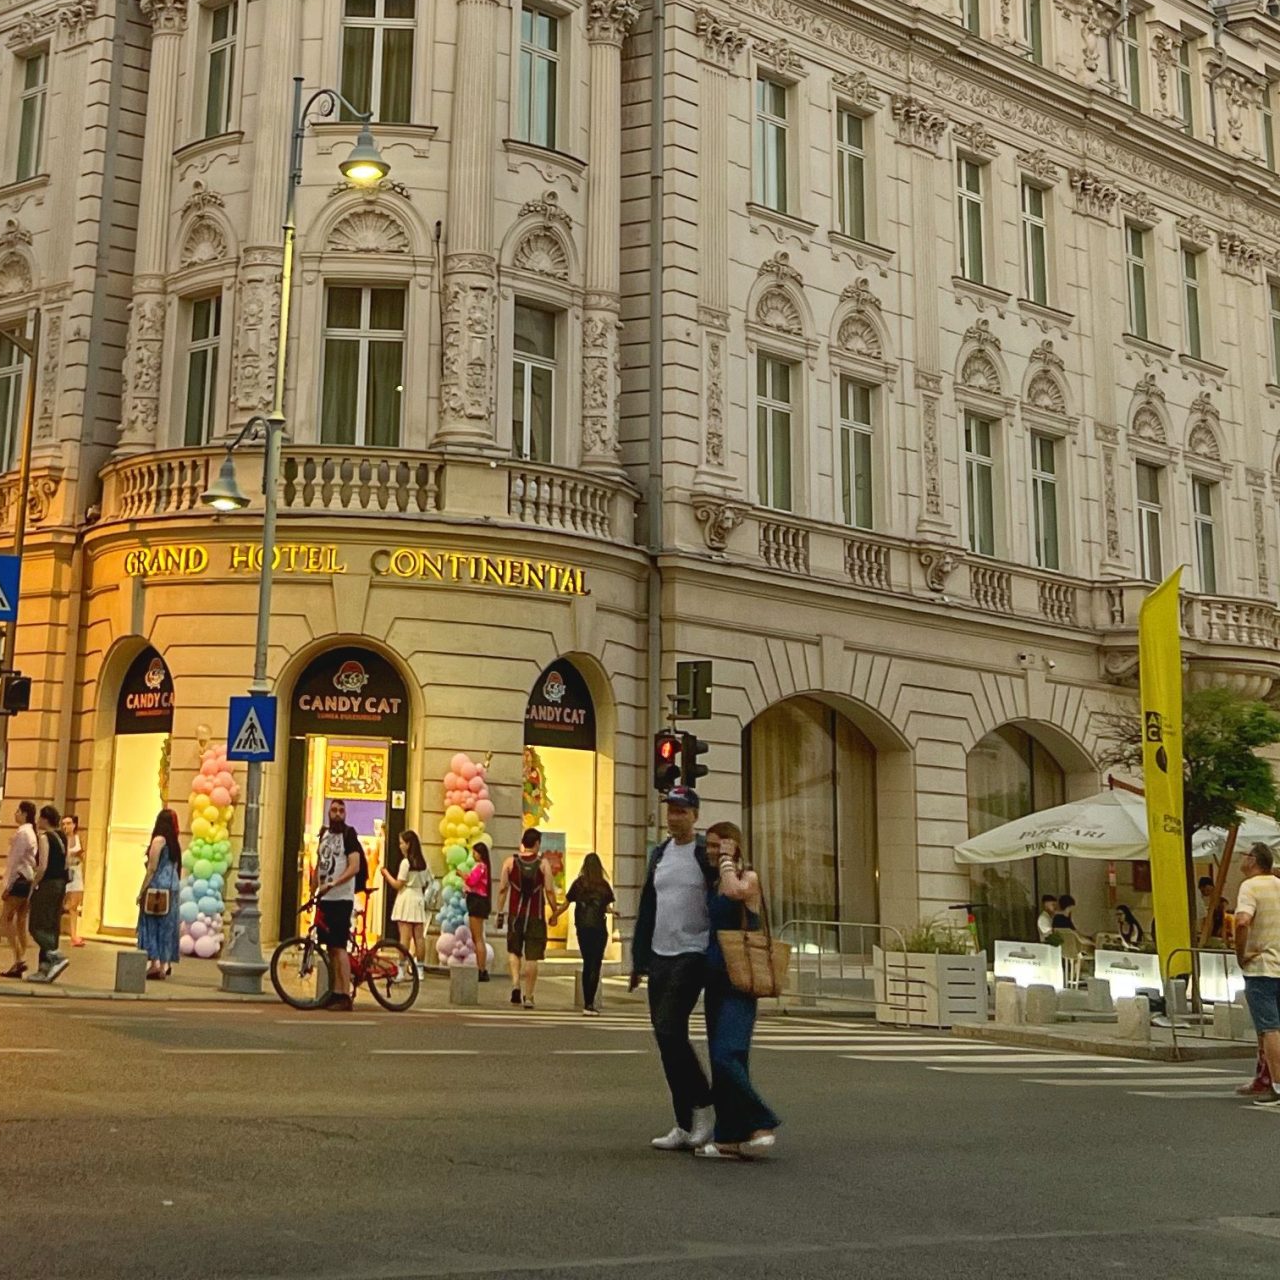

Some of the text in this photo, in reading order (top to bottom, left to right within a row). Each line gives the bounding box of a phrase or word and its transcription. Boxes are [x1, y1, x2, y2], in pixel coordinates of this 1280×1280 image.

[126, 543, 592, 597] GRAND HOTEL CONTINENTAL
[126, 692, 160, 709] CANDY
[298, 694, 402, 714] CANDY CAT
[563, 708, 587, 724] CAT
[1025, 840, 1070, 853] PURCARI
